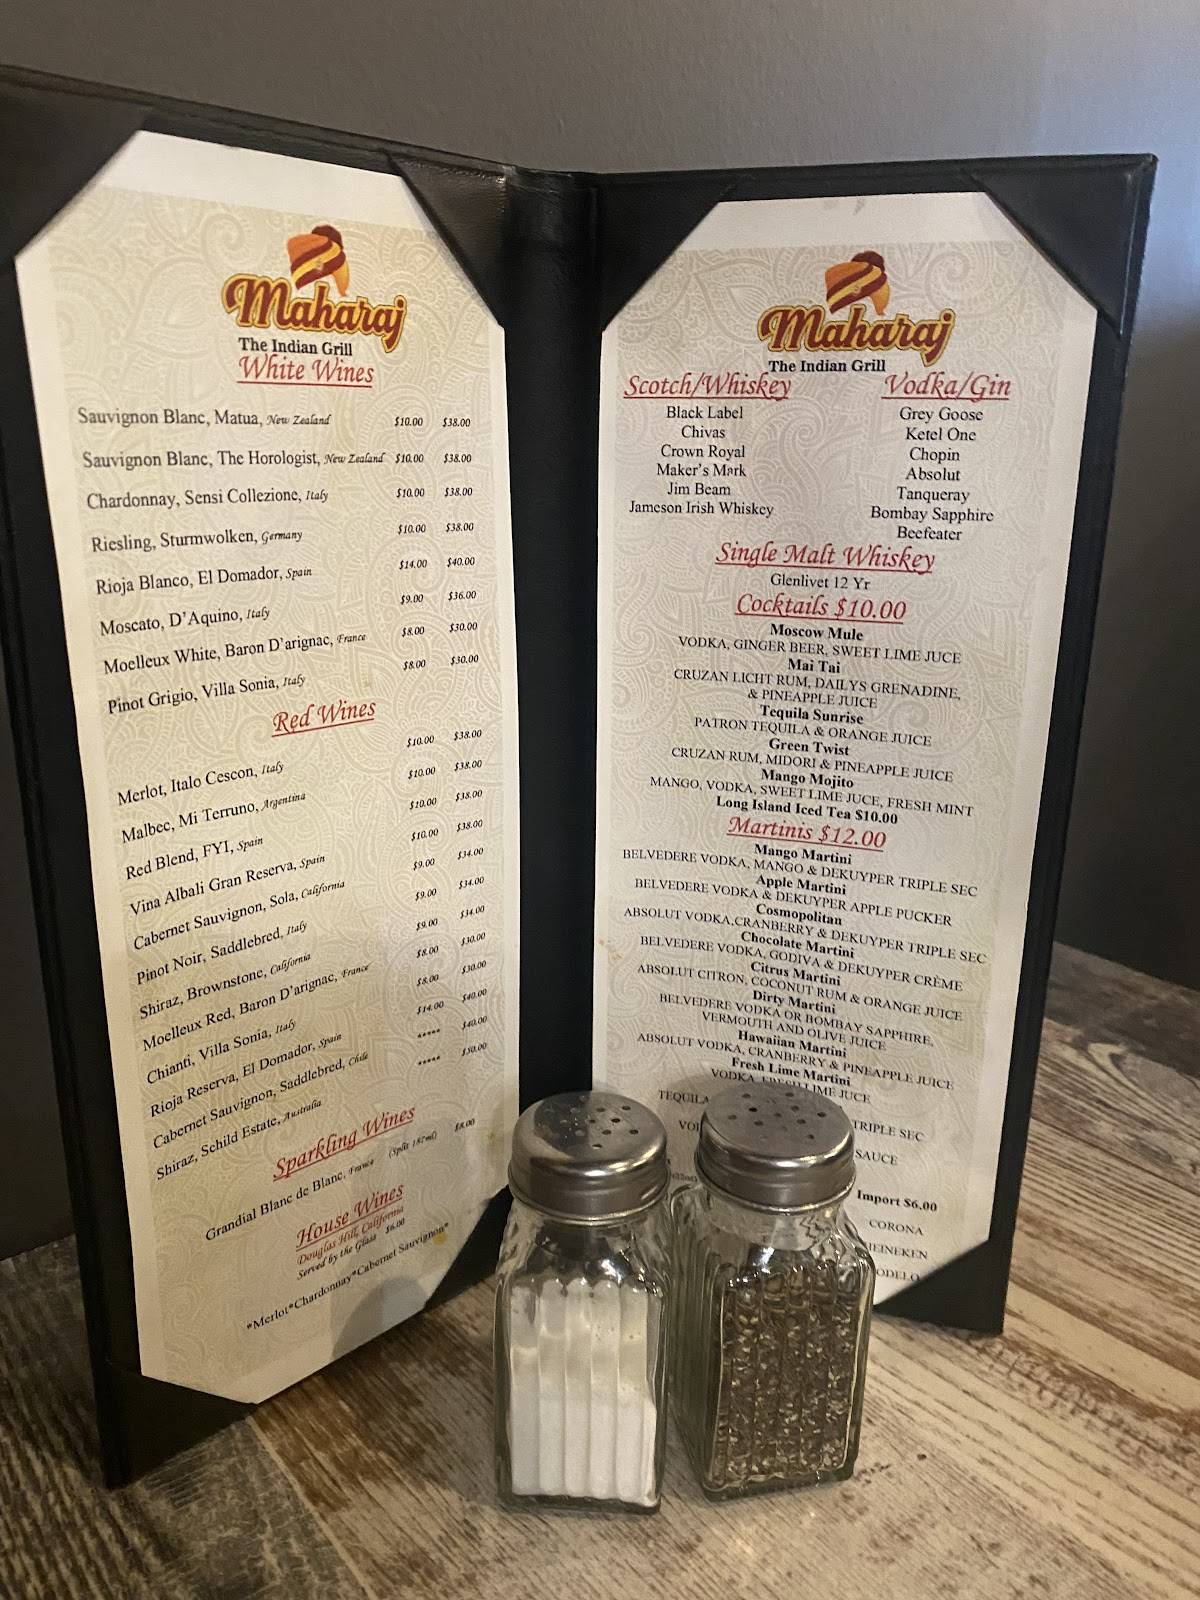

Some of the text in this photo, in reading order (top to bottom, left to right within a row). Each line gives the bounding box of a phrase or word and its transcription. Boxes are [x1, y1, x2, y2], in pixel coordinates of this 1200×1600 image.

[221, 273, 407, 353] Maharaj
[757, 303, 955, 367] Maharaj
[238, 337, 352, 356] The Indian Grill
[238, 354, 374, 384] White Wines
[768, 359, 885, 372] The Indian Grill
[624, 372, 791, 401] Scotch/Whiskey
[885, 372, 1011, 400] Vodka/Gin
[78, 407, 470, 428] Sauvignon Blanc, Matua, New Zealand $10.00 $38.00
[667, 406, 742, 419] Black Label
[900, 406, 983, 424] Grey Goose
[682, 425, 725, 438] Chivas
[906, 427, 976, 441] Ketel One
[83, 450, 471, 471] Sauvignon Blanc, The Horologist, New Zealand $10.00 $38.00
[661, 444, 744, 461] Crown Royal
[910, 447, 959, 464] Chopin
[906, 467, 960, 481] Absolut
[87, 488, 472, 509] Chardonnay, Sensi Collezione, Italy $10.00 $38.00
[668, 482, 730, 495] Jim Beam
[897, 486, 969, 504] Tanqueray
[629, 501, 773, 518] Jameson Irish Whiskey
[871, 506, 993, 524] Bombay Sapphire
[92, 523, 473, 552] Riesling, Sturmwolken, Germany $10.00 $38.00
[898, 526, 962, 540] Beefeater
[716, 543, 934, 573] Single Malt Whiskey
[96, 557, 475, 596] Rioja Blanco, El Domador, Spain $14.00 $40.00
[771, 573, 870, 590] Glenlivet 12 Yr
[100, 618, 164, 636] Moscato,
[247, 606, 270, 621] Italy
[400, 594, 423, 605] $9.00
[448, 591, 476, 601] $36.00
[737, 593, 906, 620] Cocktails $10.00
[771, 624, 863, 641] Moscow Mule
[679, 636, 729, 650] VODKA,
[734, 639, 786, 652] GINGER
[790, 642, 827, 657] BEER,
[833, 645, 878, 658] SWEET
[884, 648, 921, 661] LIME
[788, 658, 840, 673] Mai Tai
[273, 701, 376, 732] Red Wines
[760, 705, 863, 724] Tequila Sunrise
[118, 730, 482, 805] Merlot, Italo Cescon, Italy $10.00 $38.00
[762, 769, 854, 789] Mango Mojito
[122, 760, 482, 843] Malbec, Mi Terruno, Argentina $10.00 $38.00
[717, 796, 897, 824] Long Island Iced Tea $10.00
[126, 790, 482, 880] Red Blend, FYI, Spain $10.00 $38.00
[728, 816, 886, 849] Martinis $12.00
[755, 844, 851, 864] Mango Martini
[756, 874, 845, 895] Apple Martini
[756, 903, 842, 926] Cosmopolitan
[741, 931, 854, 958] Chocolate Martini
[751, 961, 841, 986] Citrus Martini
[752, 990, 835, 1015] Dirty Martini
[738, 1030, 846, 1058] Hawaiian Martini
[732, 1057, 764, 1073] Fresh
[769, 1063, 800, 1077] Lime
[804, 1069, 850, 1086] Martini
[274, 1106, 415, 1179] Sparkling Wines
[900, 1129, 924, 1142] SEC
[261, 1195, 292, 1215] Blanc
[296, 1187, 308, 1199] de
[858, 1190, 937, 1211] Import $6.00
[297, 1185, 404, 1247] House Wines
[869, 1220, 923, 1236] CORONA
